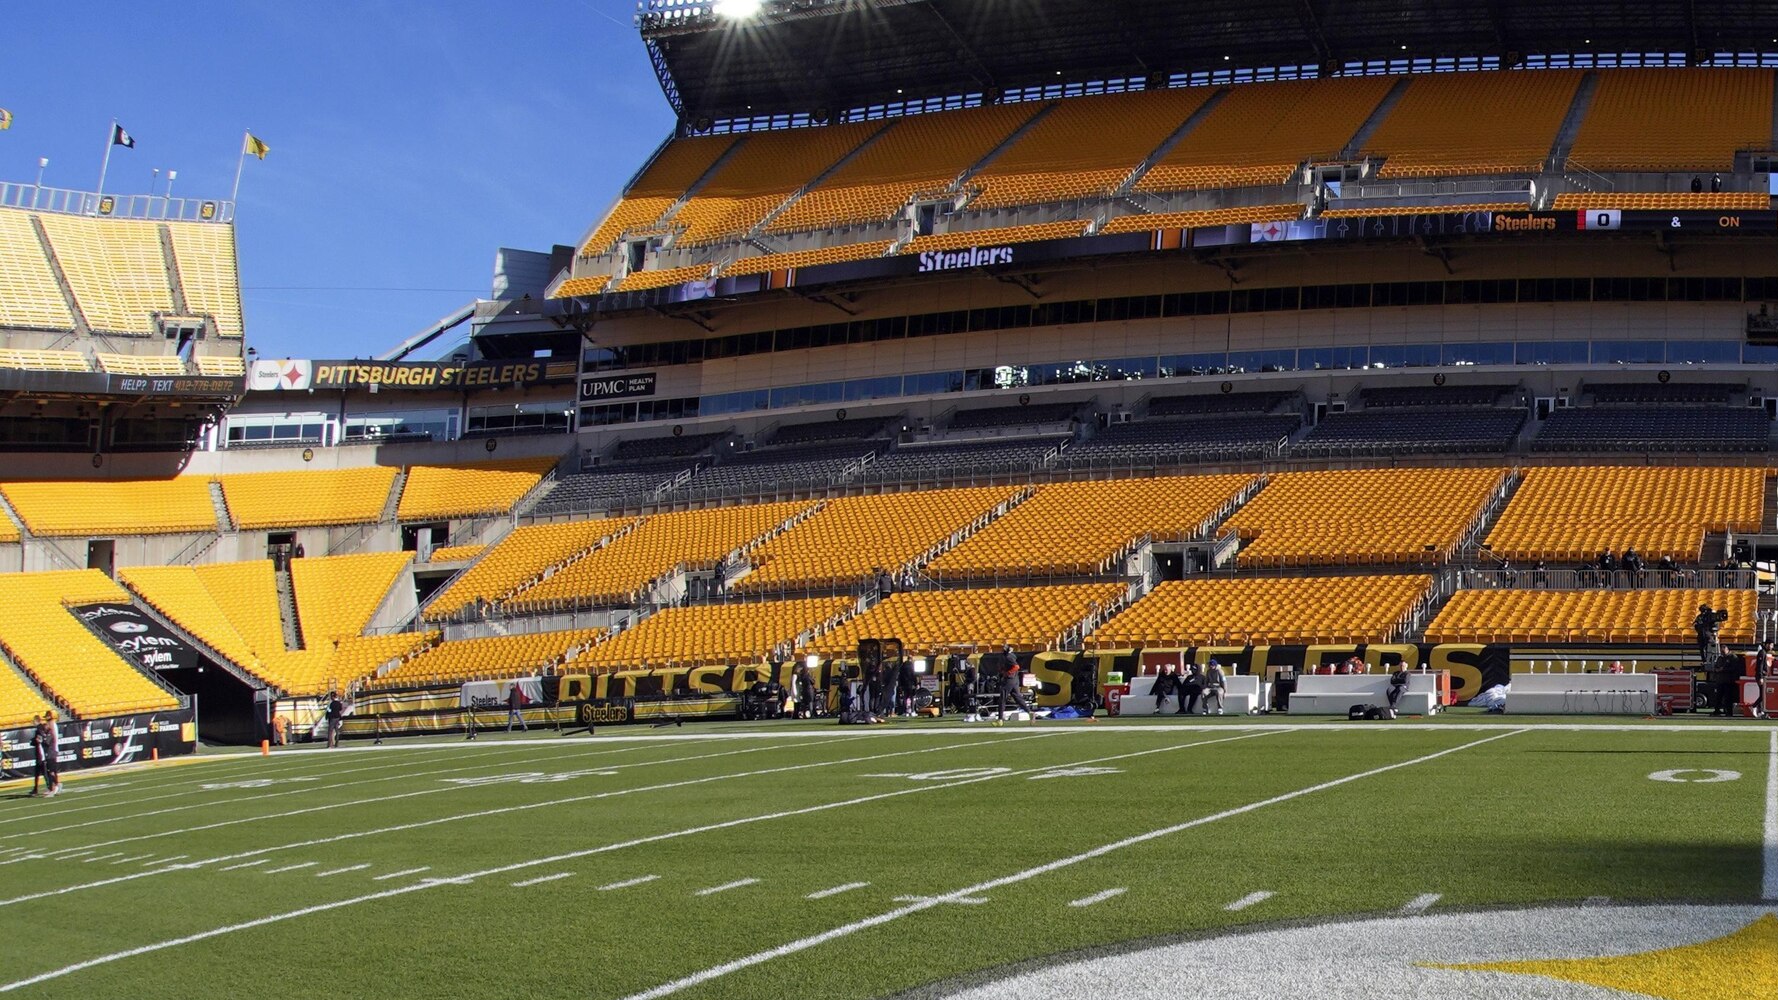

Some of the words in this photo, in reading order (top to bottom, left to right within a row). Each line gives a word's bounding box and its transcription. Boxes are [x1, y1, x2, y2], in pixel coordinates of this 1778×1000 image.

[1495, 213, 1556, 231] Steelers
[1597, 213, 1610, 227] 0
[1671, 216, 1682, 228] &
[1719, 216, 1740, 228] ON
[918, 246, 1014, 272] Steelers
[316, 365, 437, 385] PITTSBURGH
[439, 363, 540, 385] STEELERS
[629, 377, 654, 385] HEALTH
[120, 379, 147, 391] HELP?
[152, 379, 174, 392] TEXT
[583, 379, 625, 397] UPMC
[144, 650, 172, 667] xylem
[471, 695, 498, 707] Steelers
[582, 703, 628, 722] Steelers
